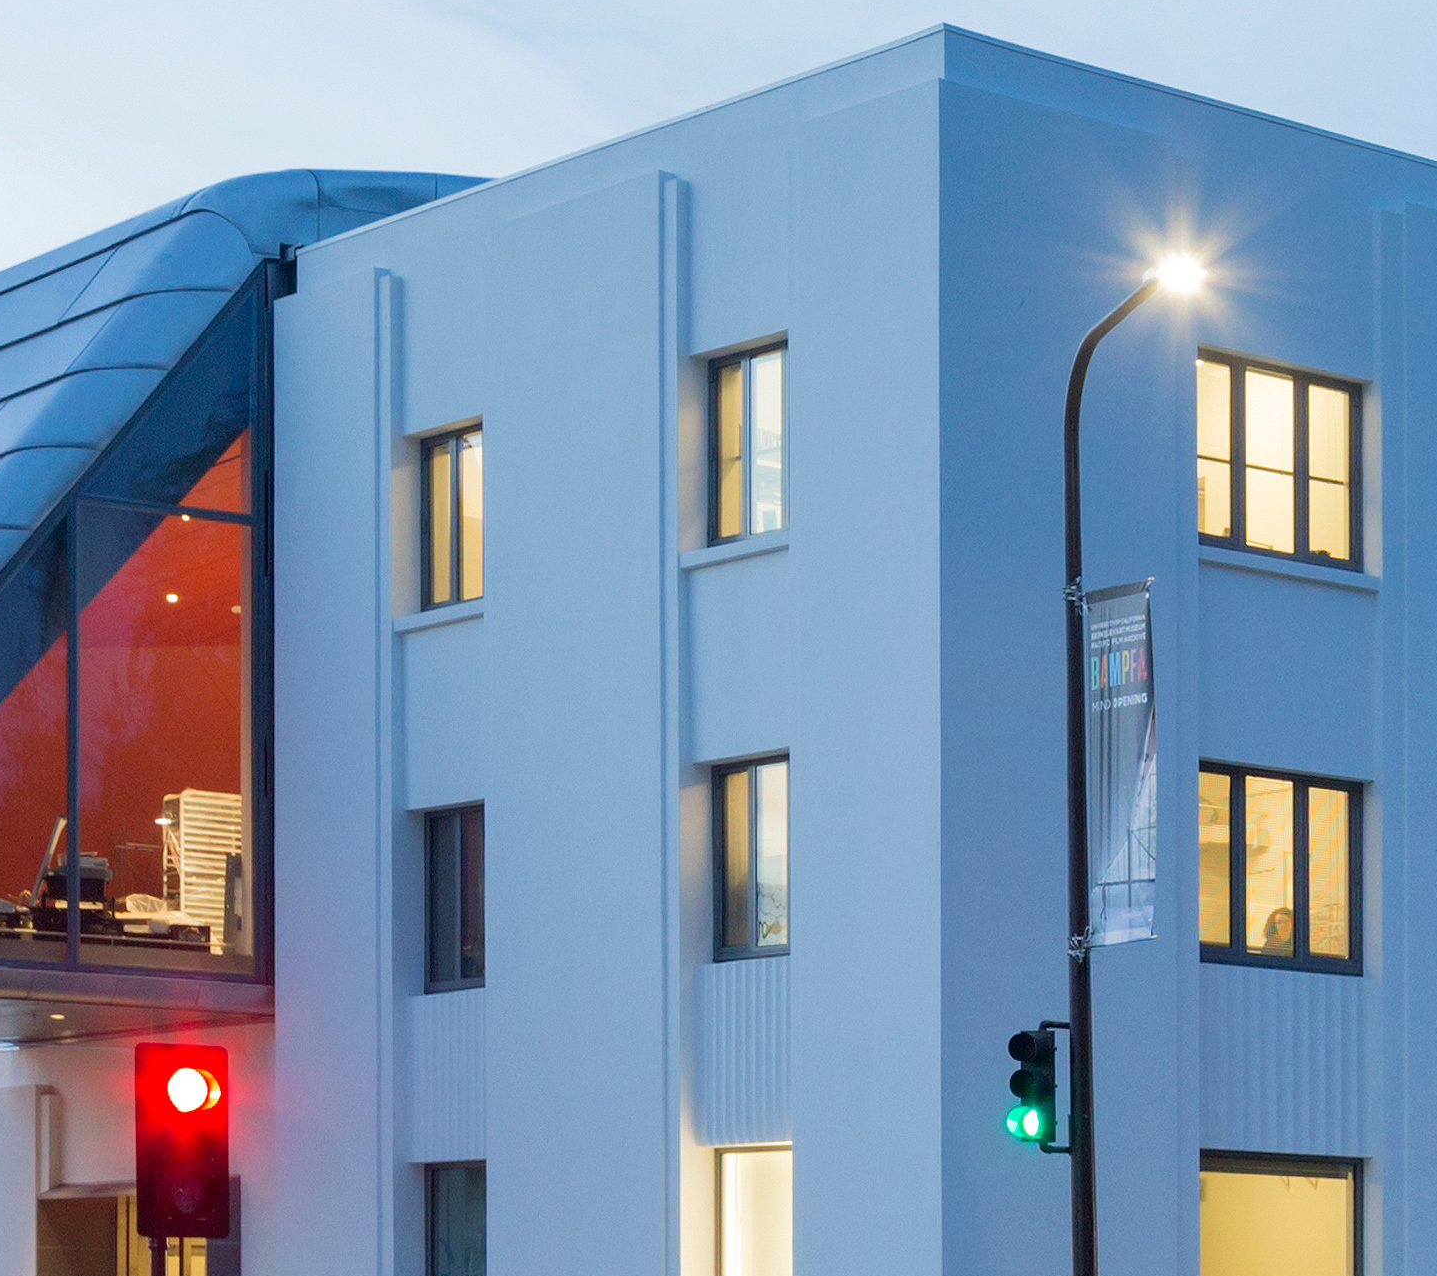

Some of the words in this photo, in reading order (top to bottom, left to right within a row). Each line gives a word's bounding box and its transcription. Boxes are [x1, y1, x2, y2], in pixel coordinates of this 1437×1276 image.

[1091, 647, 1147, 691] BAMPFA
[1091, 698, 1112, 712] MIND
[1113, 692, 1148, 708] OPENING
